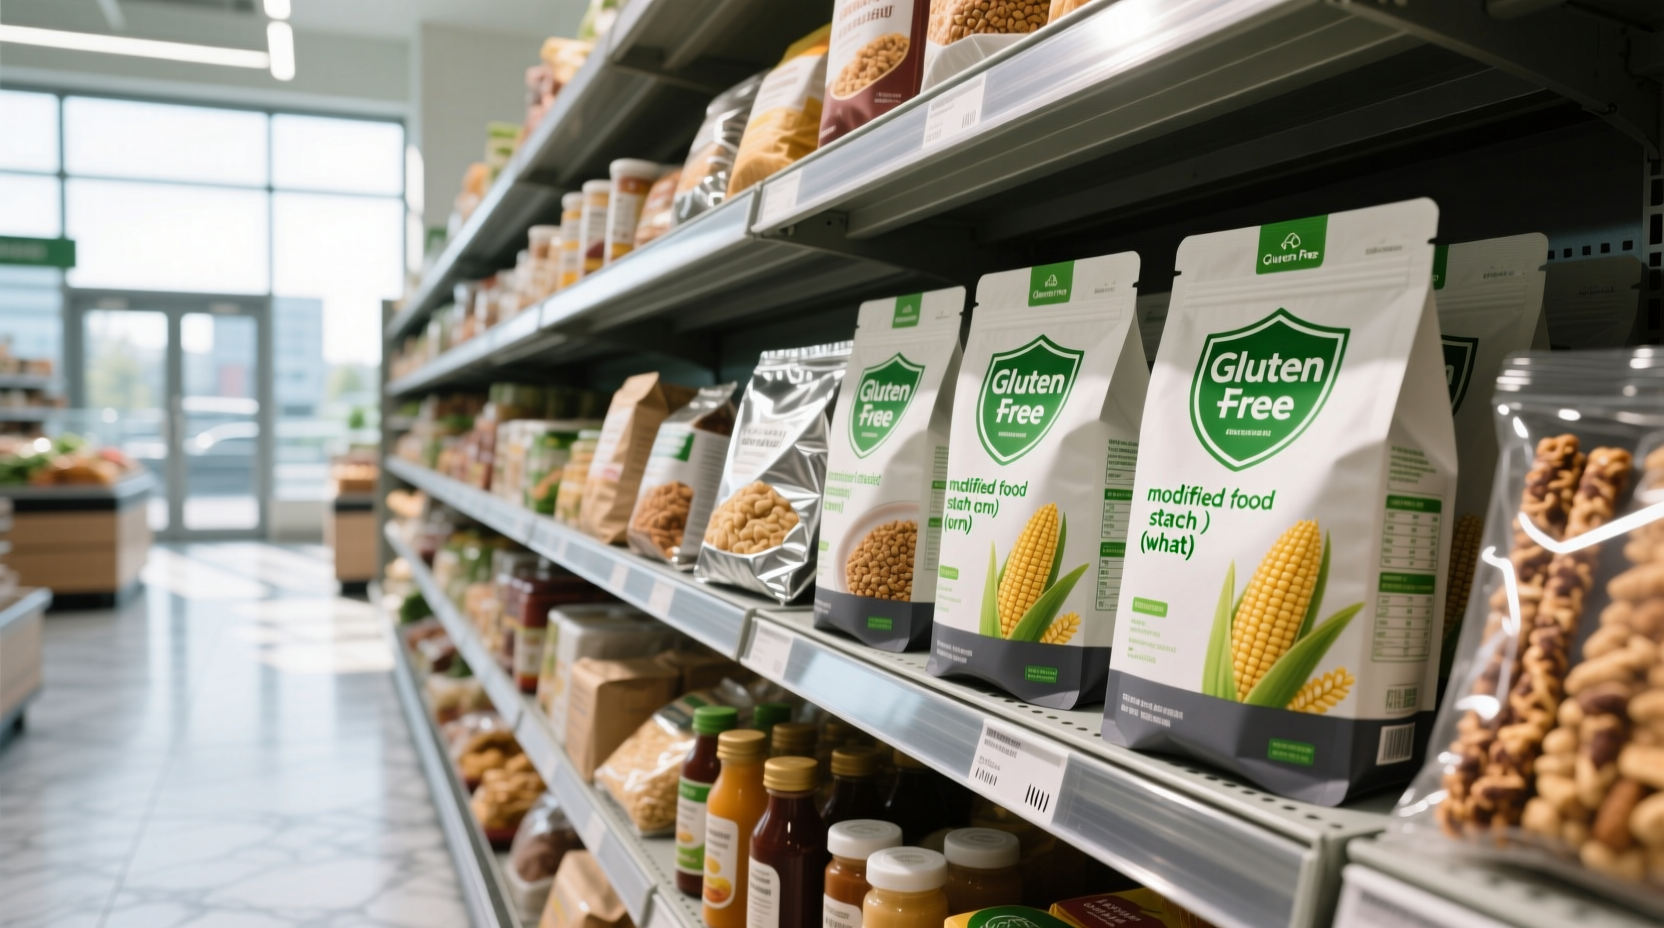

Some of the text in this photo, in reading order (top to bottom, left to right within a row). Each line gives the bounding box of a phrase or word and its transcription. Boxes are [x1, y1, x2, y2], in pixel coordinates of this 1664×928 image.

[1210, 350, 1325, 383] Gluten
[860, 378, 911, 402] Gluten
[991, 367, 1066, 394] Gluten
[858, 403, 894, 427] Free
[996, 398, 1045, 424] Free
[1216, 387, 1295, 420] Free
[999, 479, 1029, 497] food
[1147, 484, 1277, 510] modified food
[1149, 508, 1198, 530] stach
[1140, 530, 1195, 561] (what)
